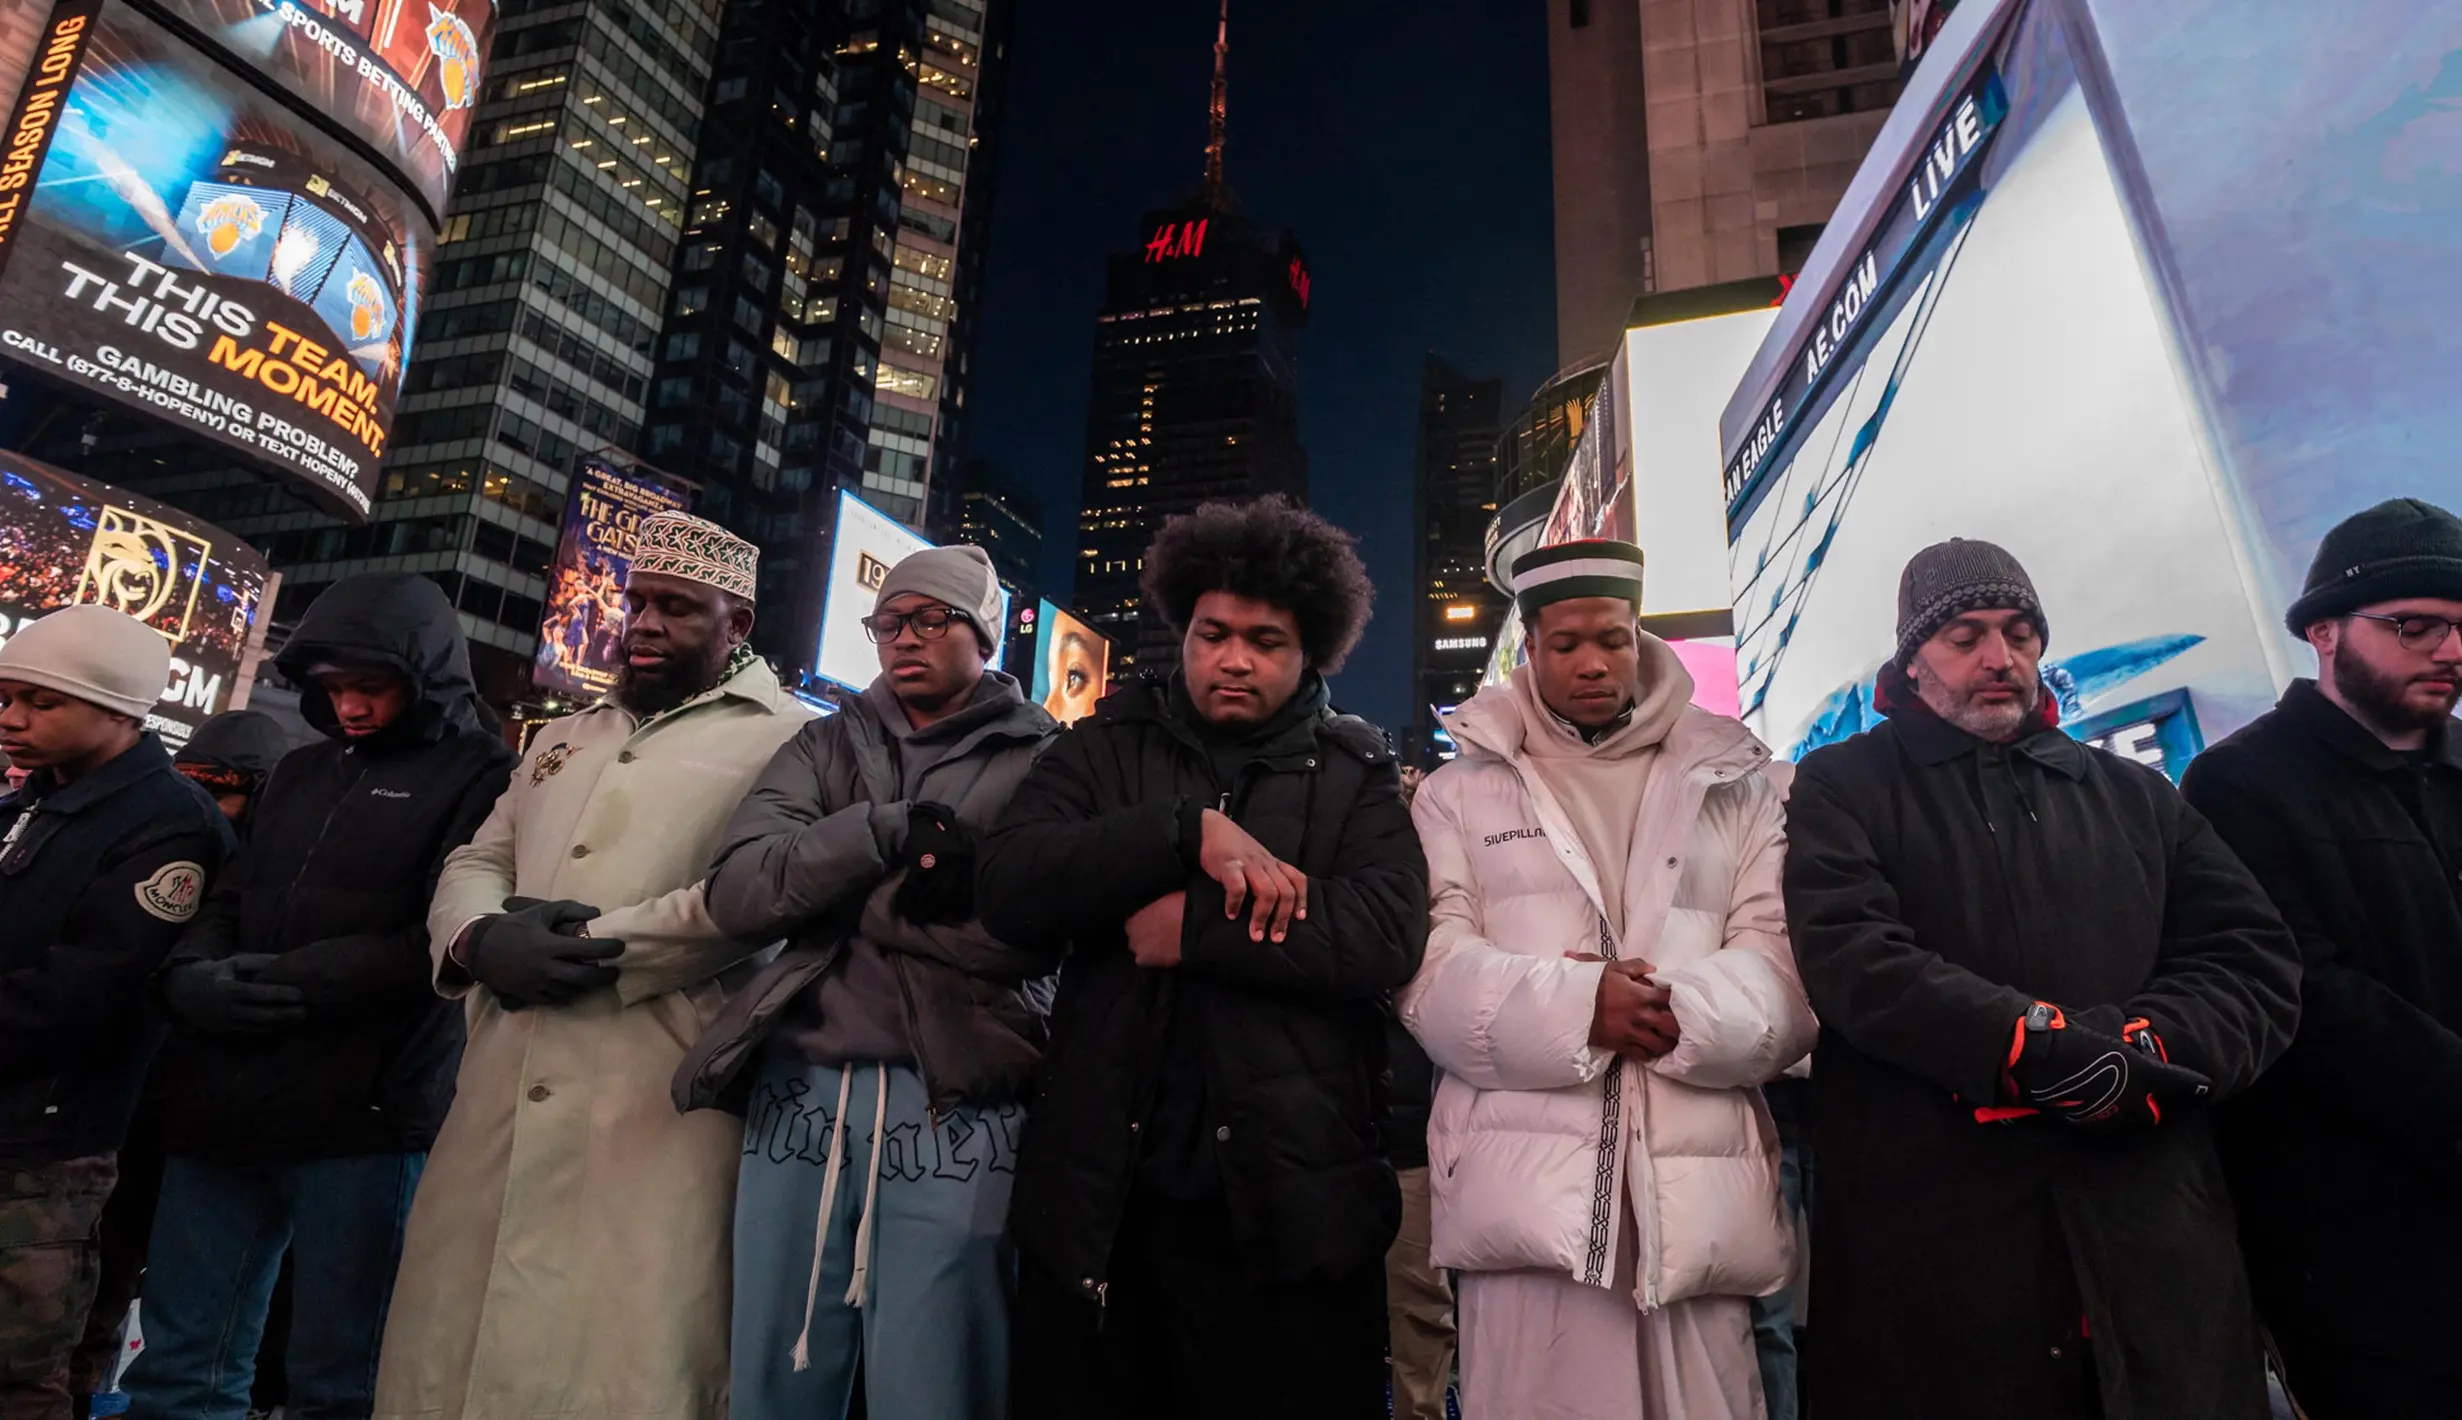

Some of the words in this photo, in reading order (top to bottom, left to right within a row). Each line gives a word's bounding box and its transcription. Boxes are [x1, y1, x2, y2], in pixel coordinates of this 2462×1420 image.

[0, 89, 60, 191] SEASON
[36, 15, 88, 88] LONG
[279, 1, 357, 66] SPORTS
[357, 56, 426, 125] BETTING
[1145, 218, 1208, 263] H&M
[1742, 398, 1784, 480] EAGLE
[1806, 250, 1879, 384] AE.COM
[1911, 94, 1982, 222] LIVE
[61, 261, 203, 351] THIS
[208, 334, 385, 458] MOMENT.
[125, 251, 256, 338] THIS
[265, 321, 379, 414] TEAM.
[2, 330, 63, 364] CALL
[67, 354, 226, 431] (877-8-HOPENY)
[228, 423, 256, 443] OR
[257, 433, 300, 461] TEXT
[300, 453, 349, 489] HOPENY
[96, 345, 253, 424] GAMBLING
[256, 412, 360, 479] PROBLEM?
[581, 496, 614, 524] THE
[586, 520, 641, 552] GATS
[602, 481, 665, 510] EXTRAVAGANZA
[1020, 623, 1033, 634] LG
[1435, 637, 1487, 650] SAMSUNG
